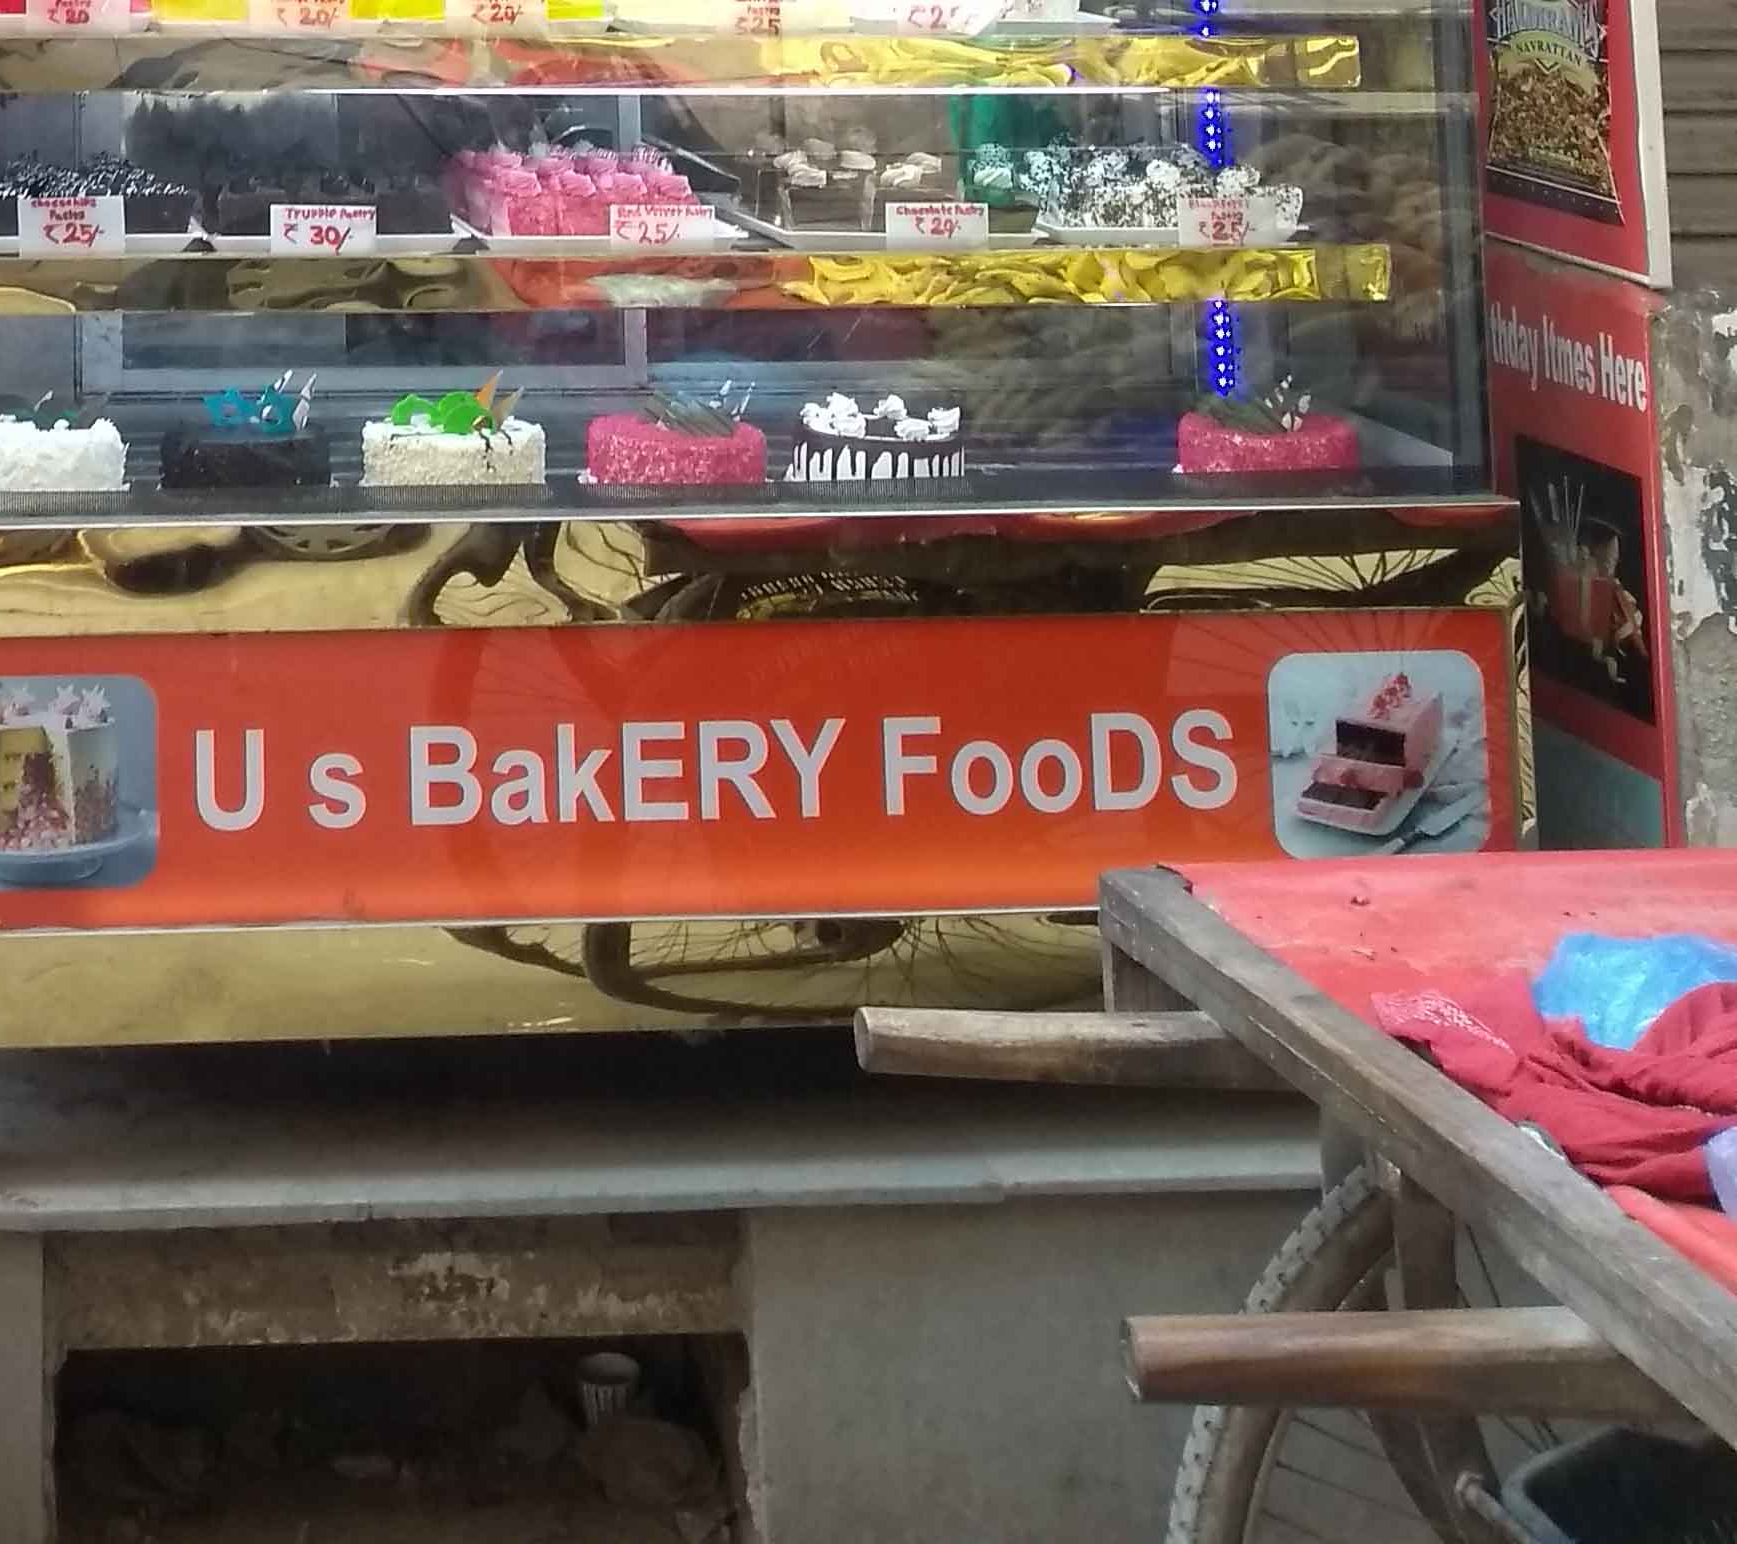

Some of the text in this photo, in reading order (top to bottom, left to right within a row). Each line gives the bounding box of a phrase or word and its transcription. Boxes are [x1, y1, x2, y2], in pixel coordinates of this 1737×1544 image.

[1486, 301, 1539, 392] thday
[1598, 331, 1648, 413] Here
[194, 709, 1239, 832] U s BakERY FooDS
